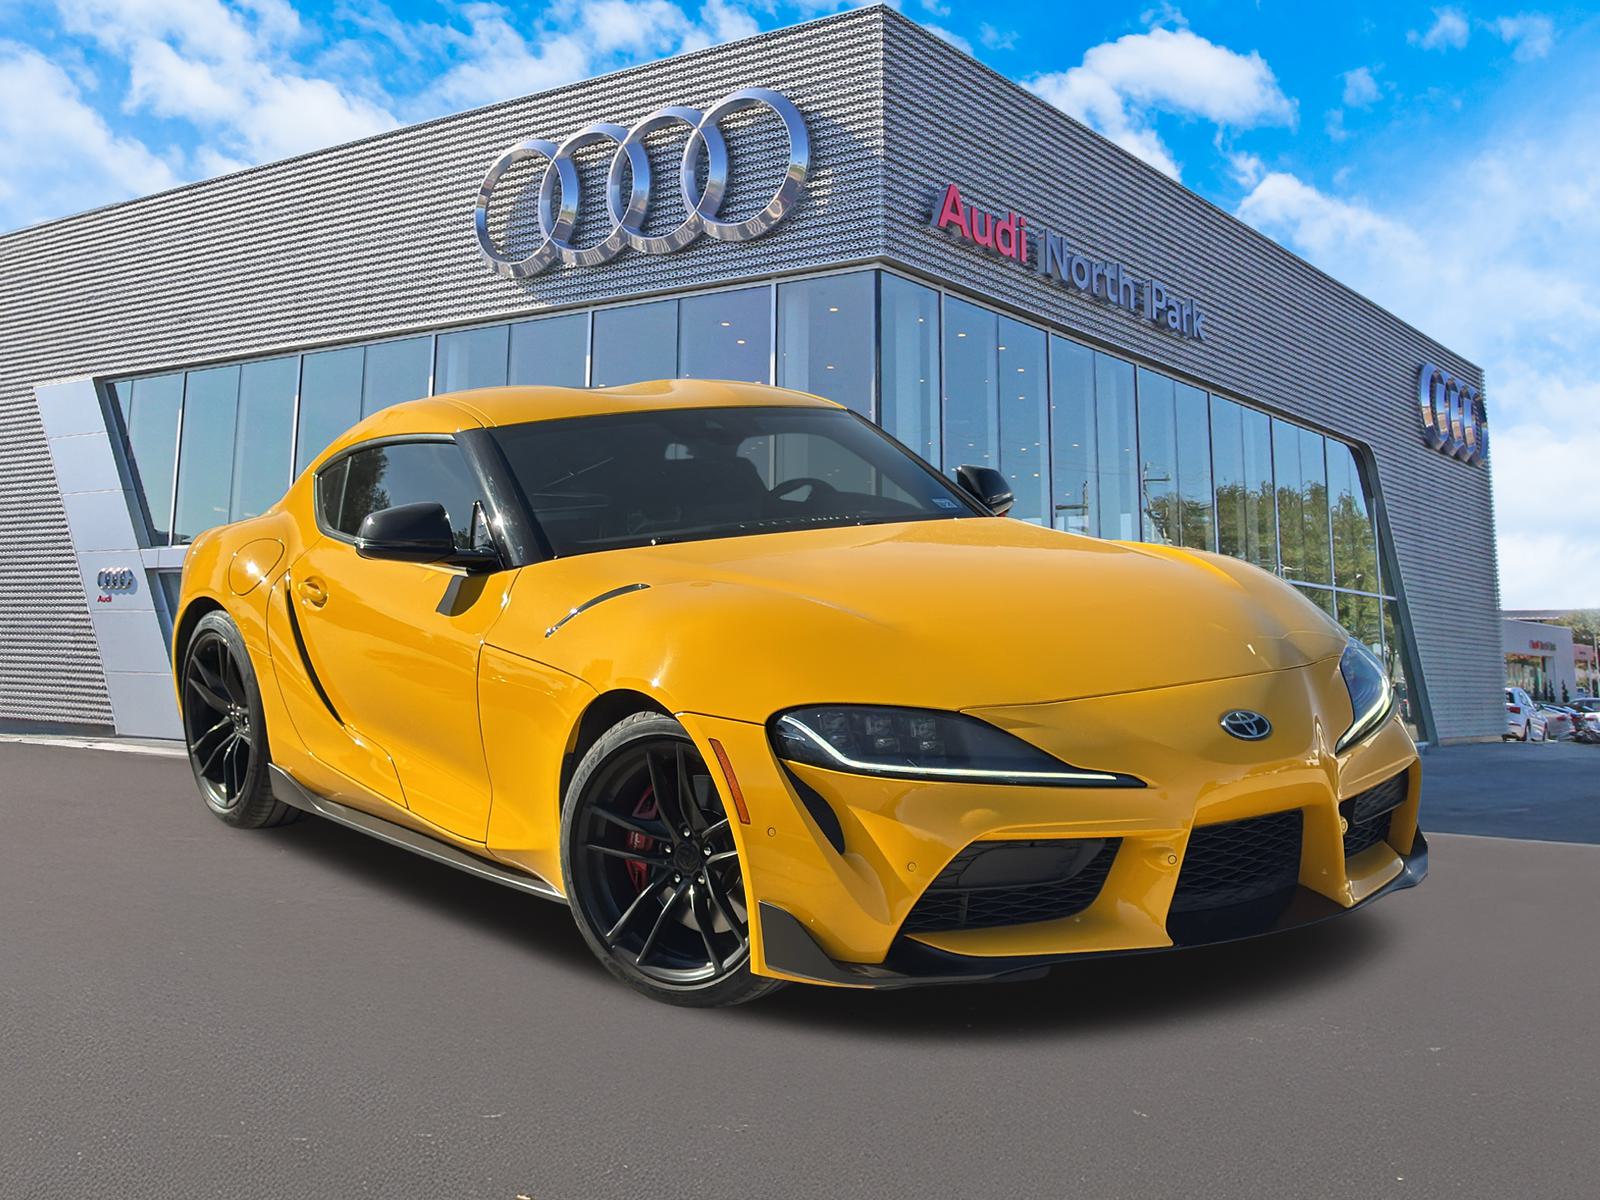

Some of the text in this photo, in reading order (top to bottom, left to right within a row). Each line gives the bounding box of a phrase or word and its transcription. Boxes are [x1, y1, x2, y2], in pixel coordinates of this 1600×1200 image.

[935, 183, 1208, 341] Audi North Park
